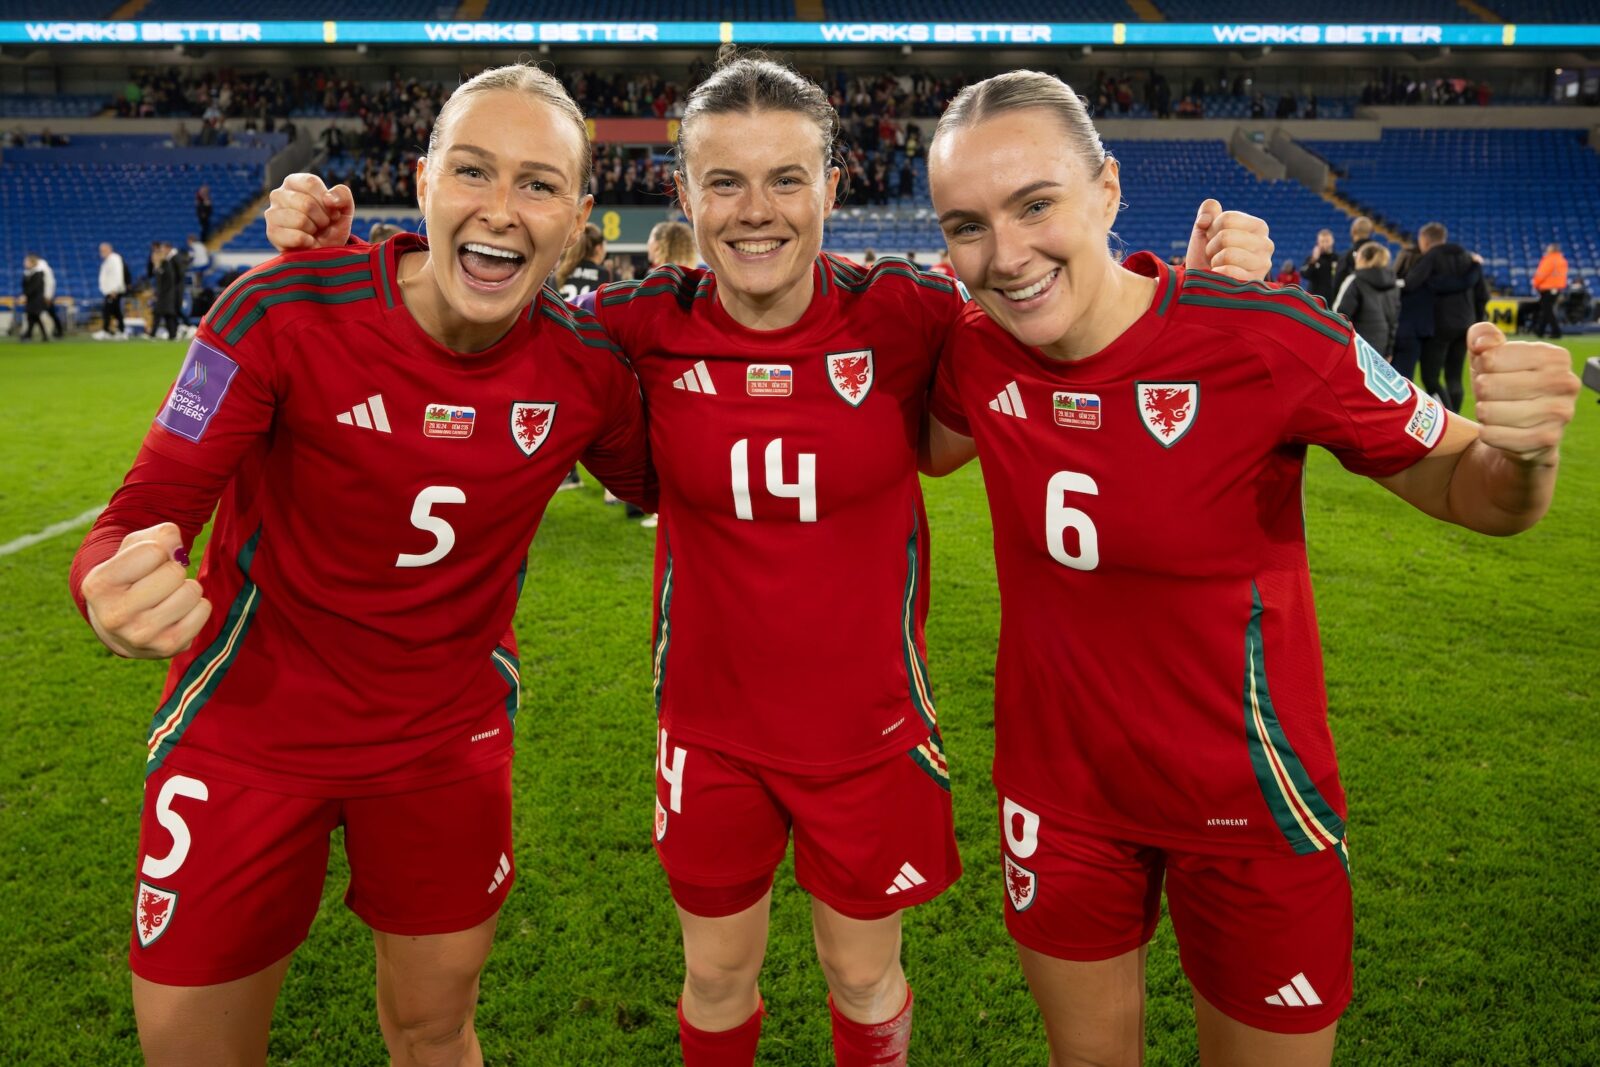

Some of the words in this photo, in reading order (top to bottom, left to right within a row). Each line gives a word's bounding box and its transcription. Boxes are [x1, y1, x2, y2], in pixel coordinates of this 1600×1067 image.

[25, 23, 138, 42] WORKS
[140, 23, 262, 42] BETTER
[423, 23, 536, 42] WORKS
[538, 23, 659, 42] BETTER
[819, 24, 930, 43] WORKS
[933, 24, 1053, 43] BETTER
[1211, 25, 1321, 43] WORKS
[1324, 25, 1442, 44] BETTER
[1408, 410, 1423, 433] UEFA
[730, 437, 817, 522] 14
[395, 485, 467, 568] 5
[1045, 470, 1099, 571] 6
[659, 727, 688, 815] 4
[141, 774, 209, 879] 5
[1207, 818, 1248, 826] AEROREADY
